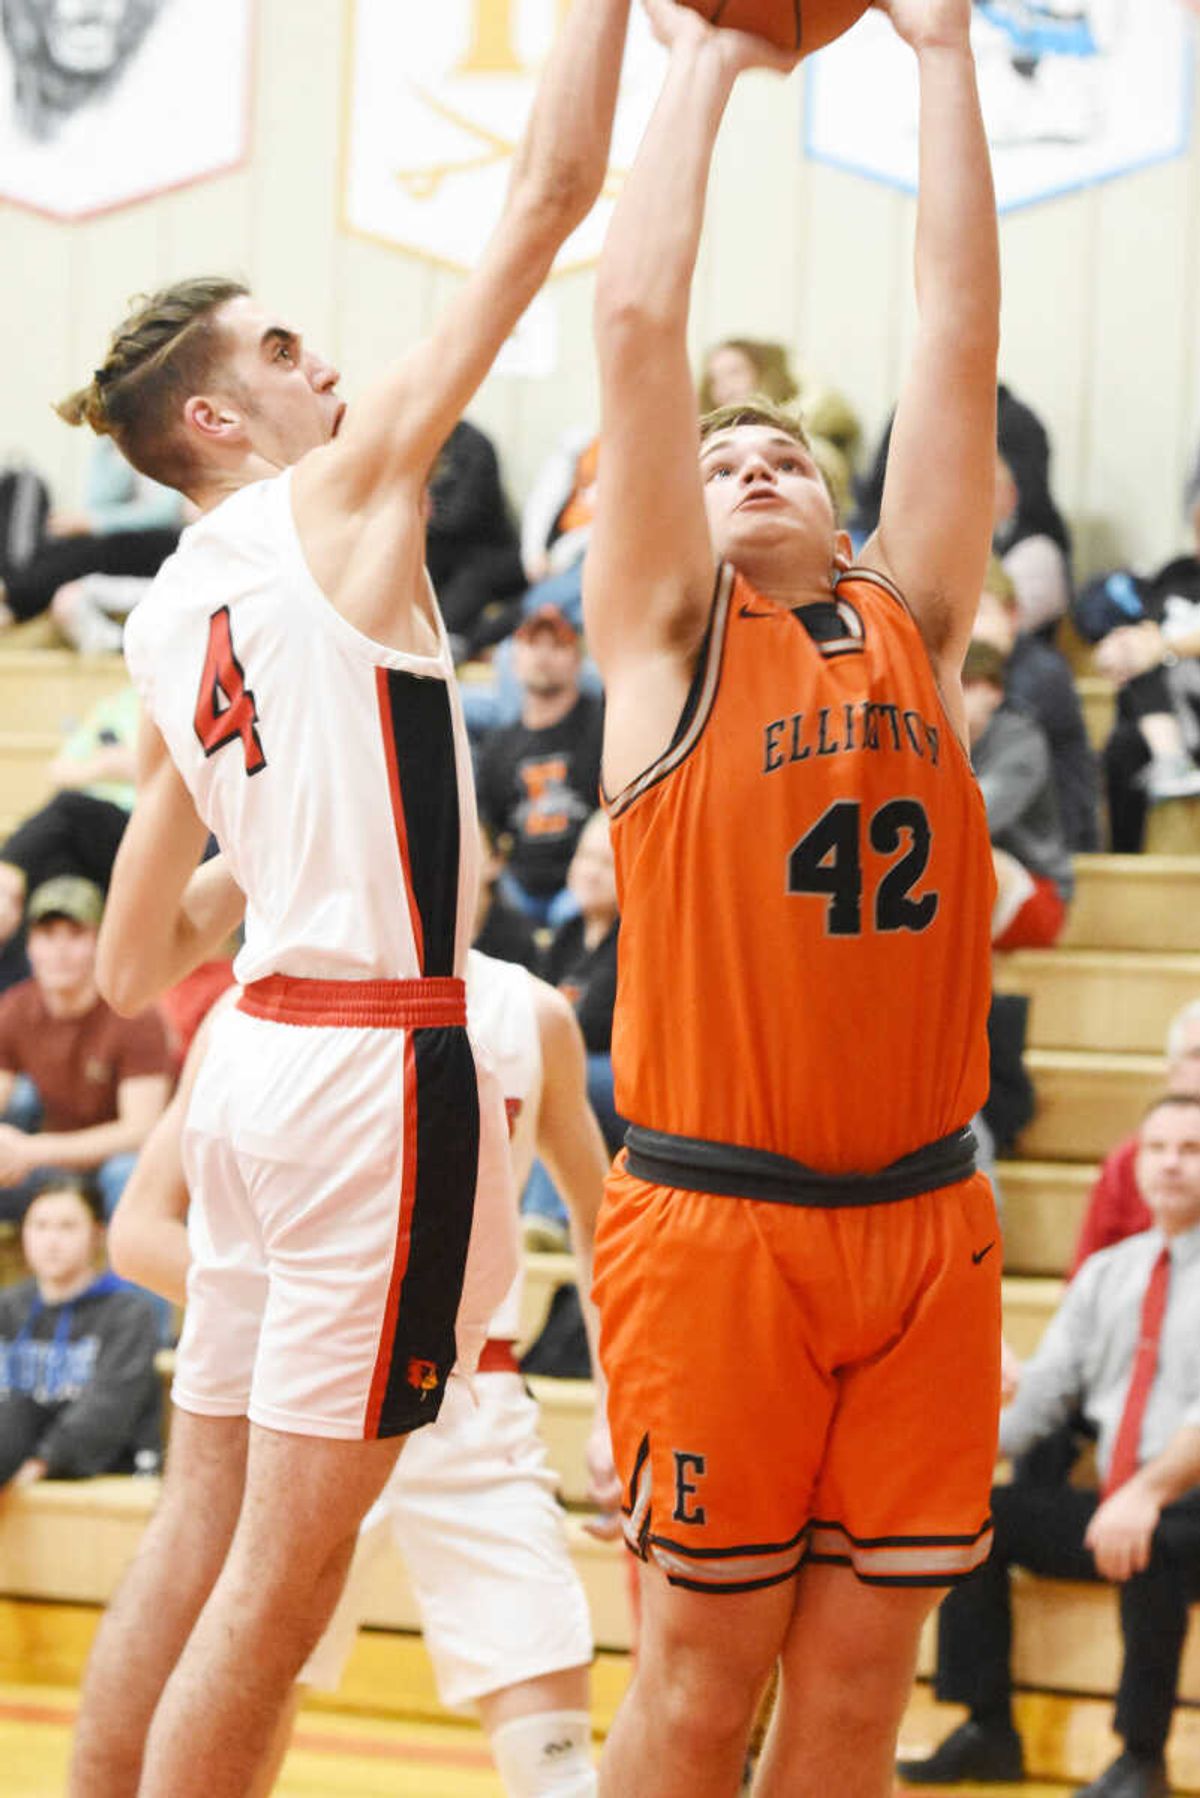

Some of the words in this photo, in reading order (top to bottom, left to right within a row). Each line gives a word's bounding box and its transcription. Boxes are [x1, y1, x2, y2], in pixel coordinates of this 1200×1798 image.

[194, 604, 267, 777] 4
[786, 796, 939, 938] 42
[672, 1451, 707, 1526] E
